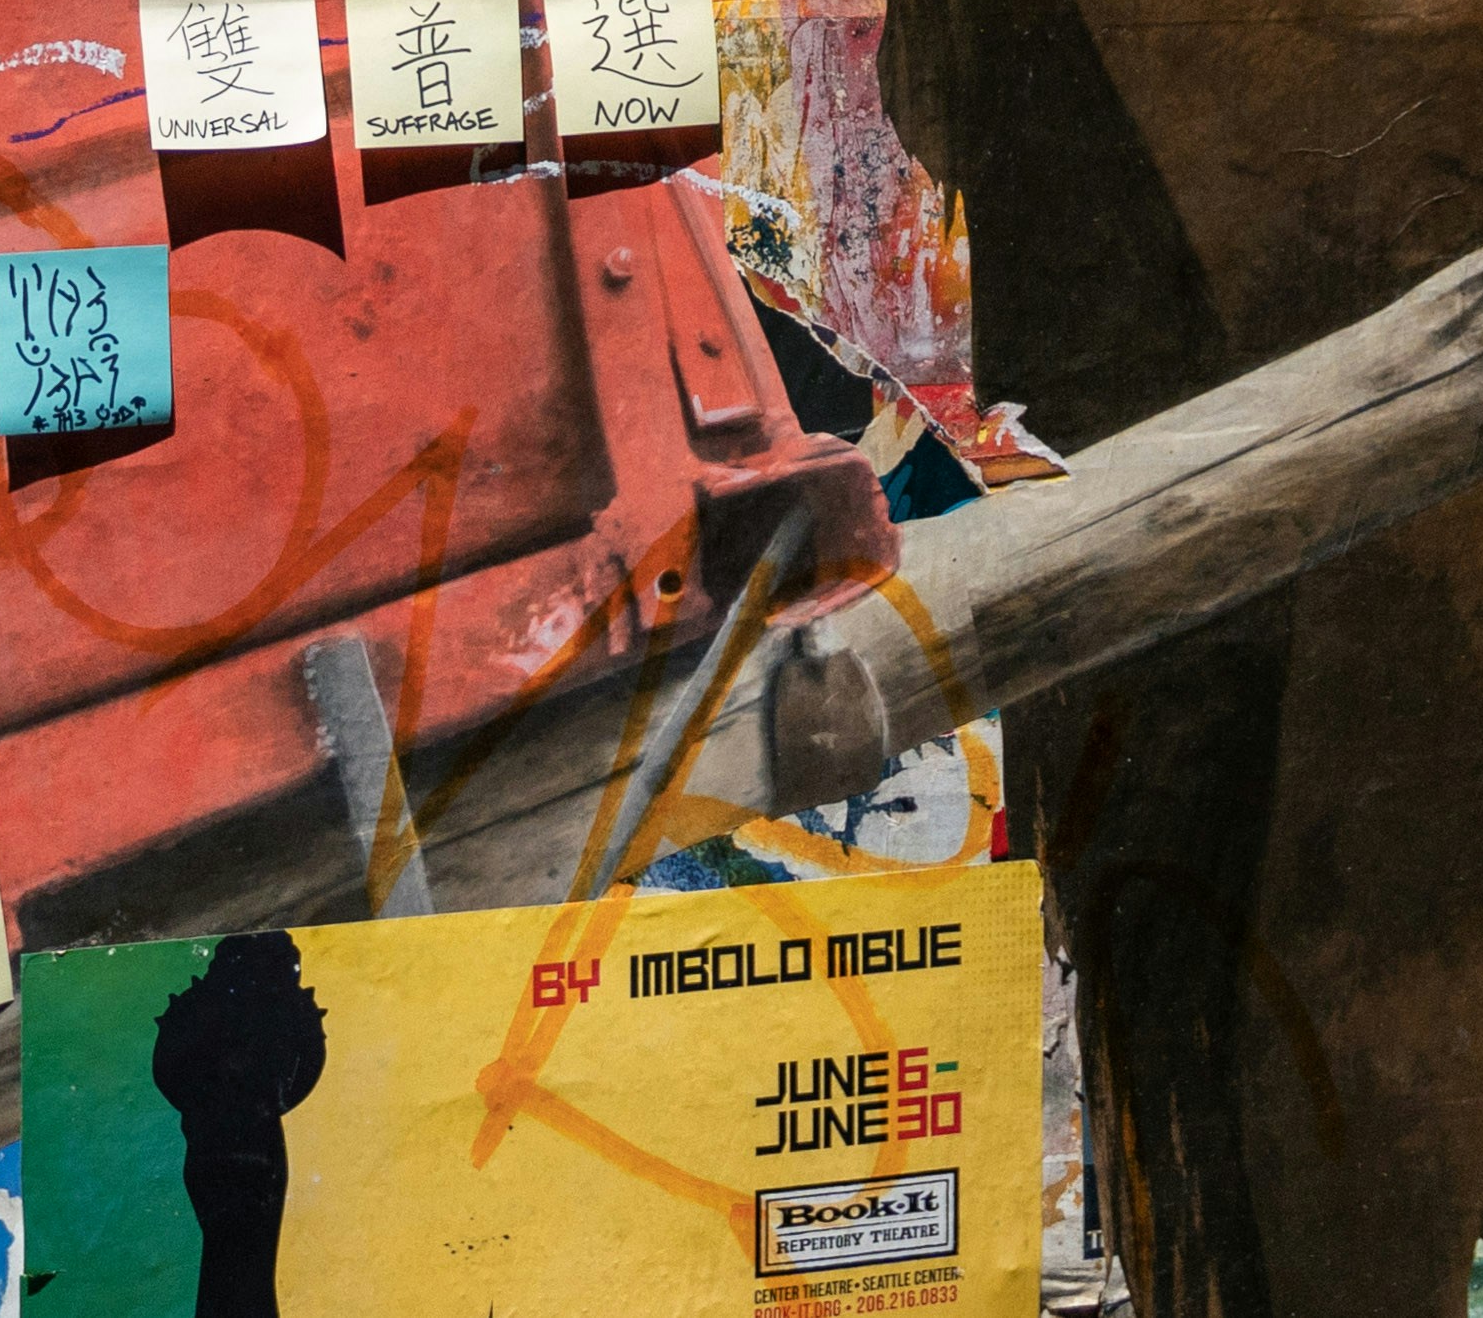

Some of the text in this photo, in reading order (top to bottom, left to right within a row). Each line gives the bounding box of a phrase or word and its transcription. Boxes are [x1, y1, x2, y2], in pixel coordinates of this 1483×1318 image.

[167, 1, 274, 105] 雙
[390, 1, 473, 108] 普
[156, 110, 288, 140] UNIVERSAL
[367, 108, 499, 135] SUFFRAGE
[593, 98, 682, 127] NOW
[531, 923, 963, 1007] BY IMBOLO MBUE
[755, 1051, 890, 1111] JUNE
[755, 1092, 963, 1158] JUNE 30
[776, 1223, 940, 1255] REPERTORY THEATRE
[857, 1285, 959, 1314] 206.216.0833
